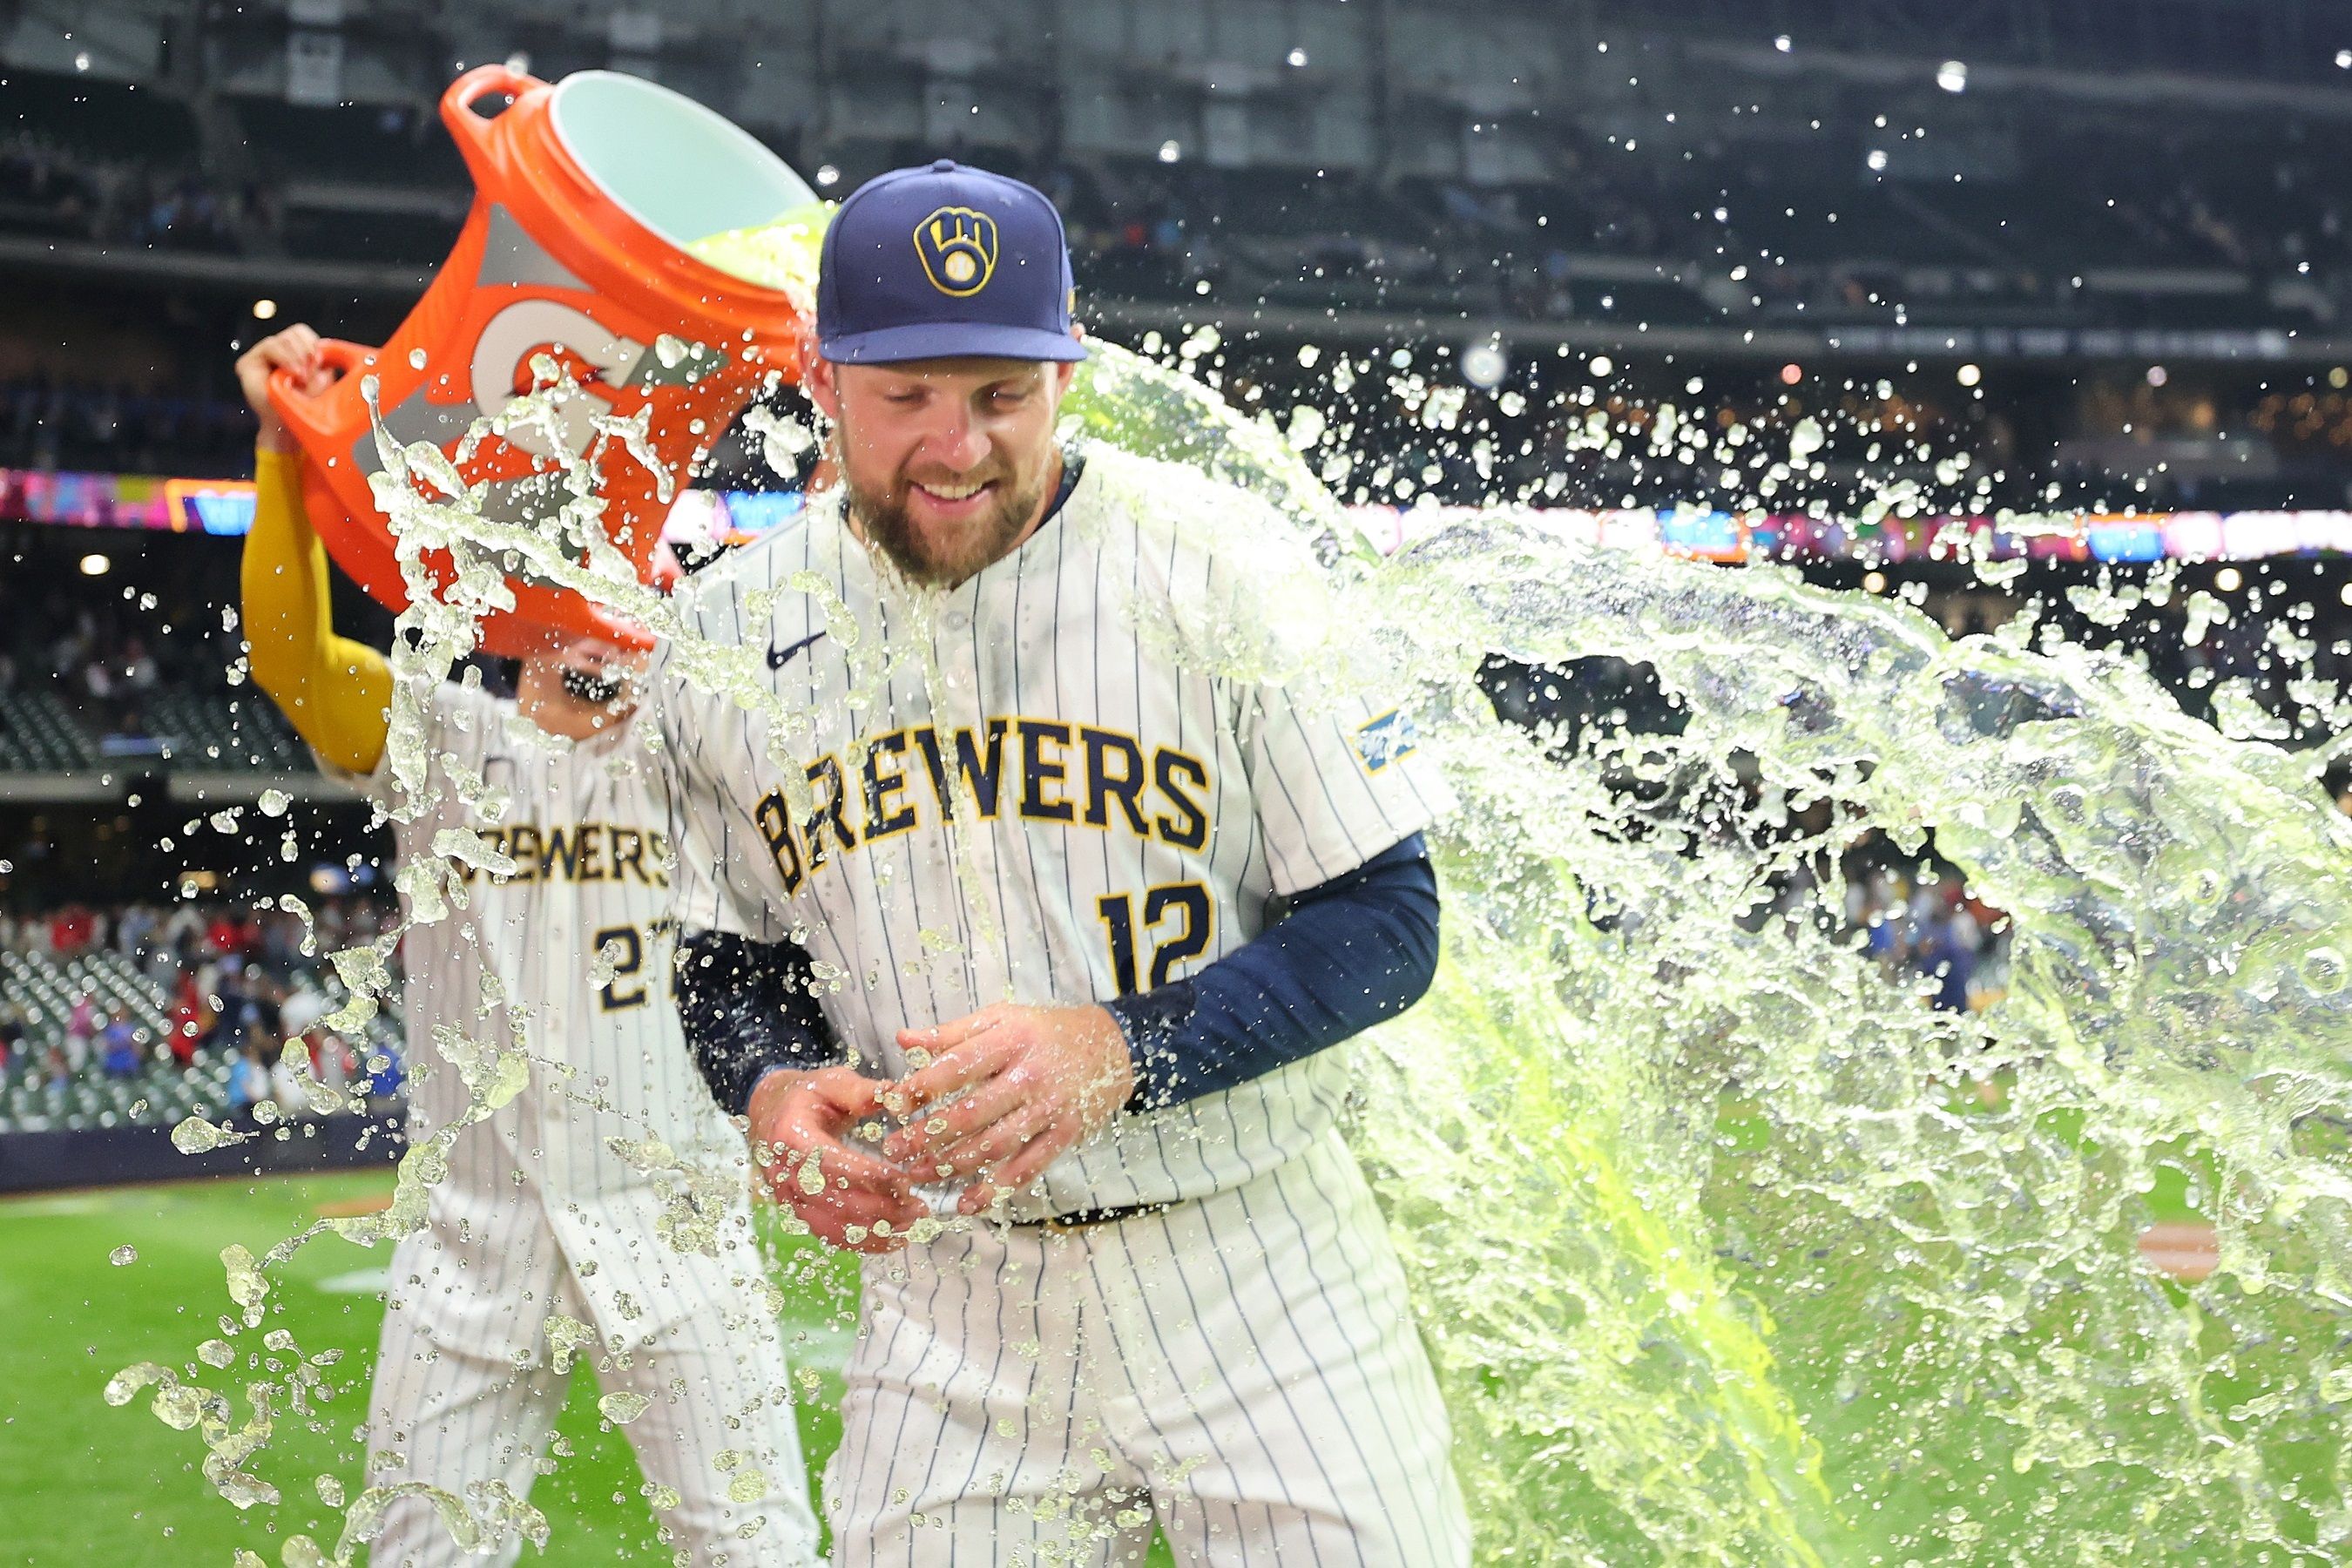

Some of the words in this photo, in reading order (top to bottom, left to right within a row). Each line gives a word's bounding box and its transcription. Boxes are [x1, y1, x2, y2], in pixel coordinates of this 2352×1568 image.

[451, 823, 670, 889] EWERS
[754, 713, 1212, 901] BREWERS
[1095, 880, 1216, 997] 12
